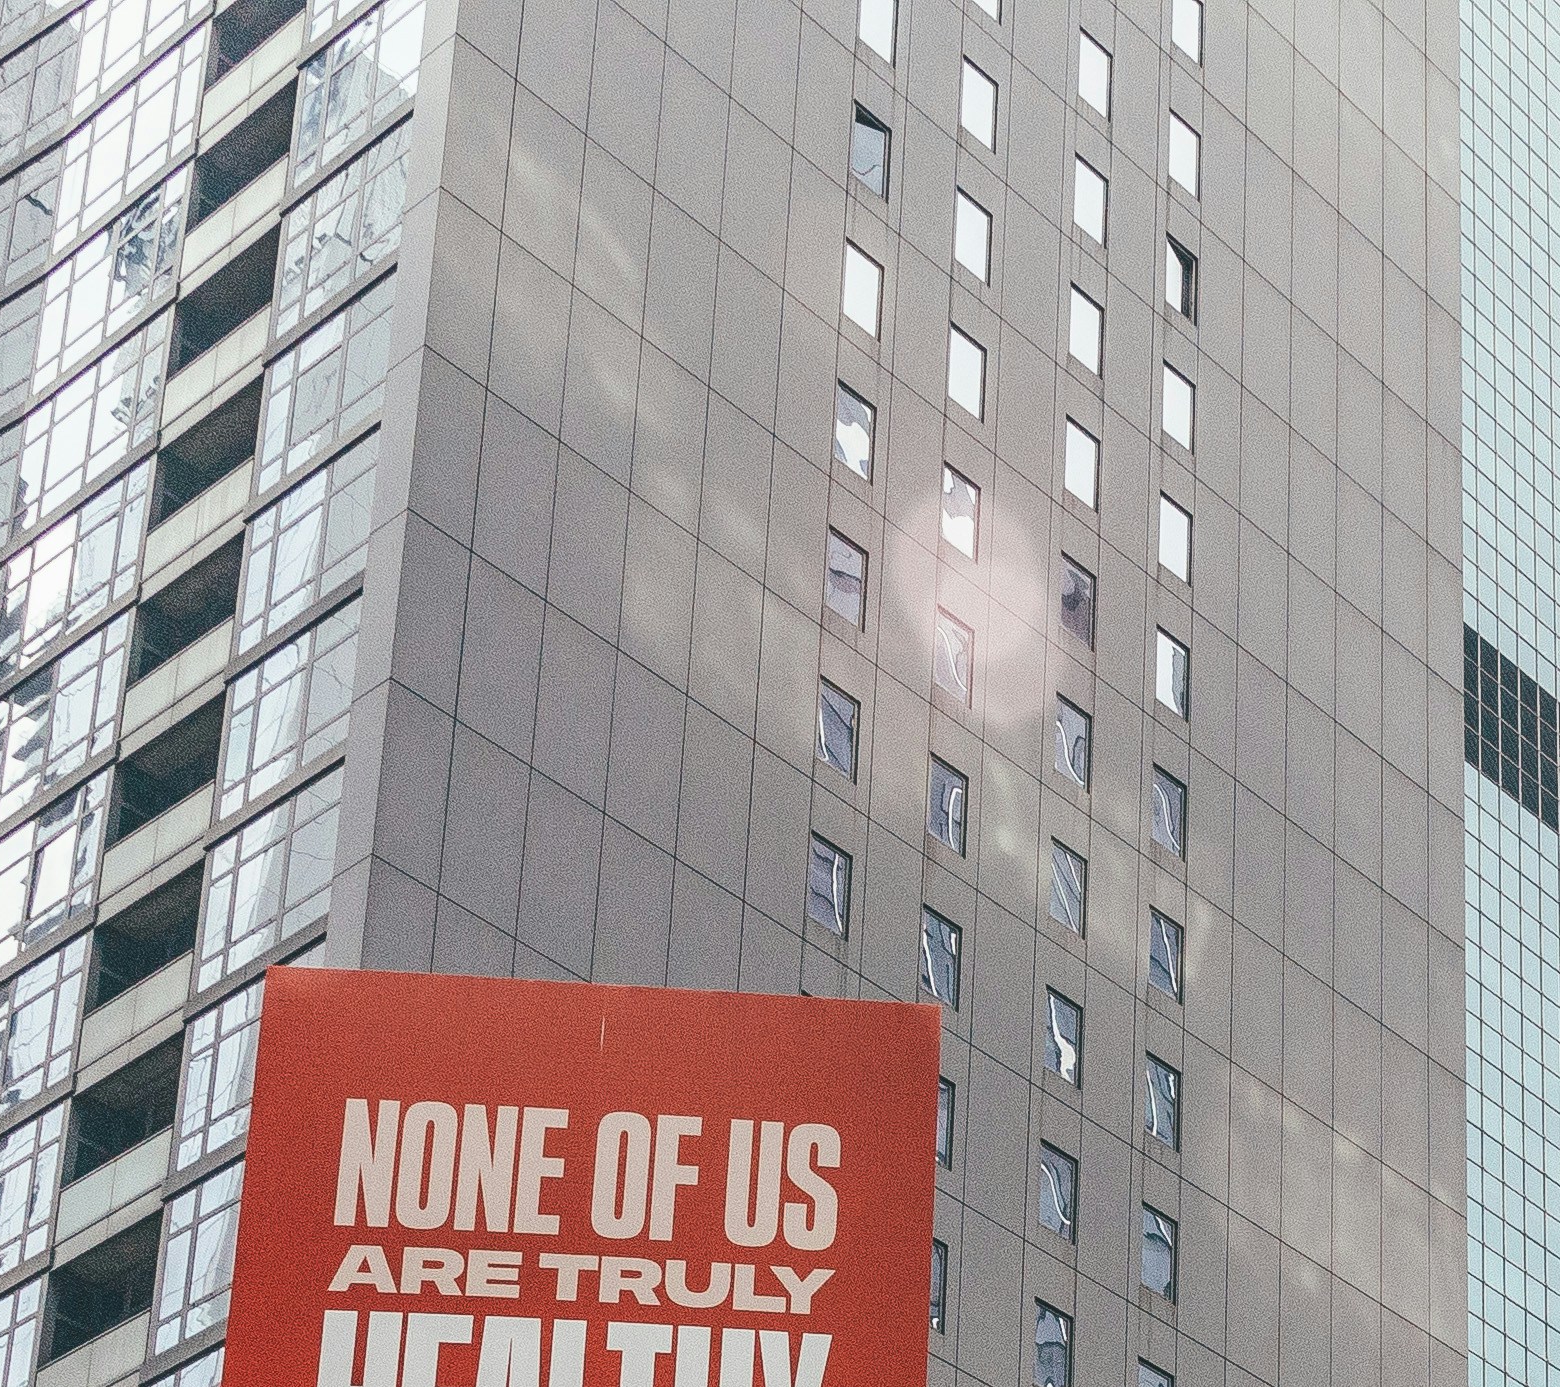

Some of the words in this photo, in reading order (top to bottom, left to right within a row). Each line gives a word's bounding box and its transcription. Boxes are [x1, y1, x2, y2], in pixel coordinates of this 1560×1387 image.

[334, 1098, 570, 1235] NONE
[595, 1113, 701, 1240] OF
[726, 1120, 842, 1249] US
[327, 1244, 521, 1298] ARE
[543, 1252, 837, 1316] TRULY
